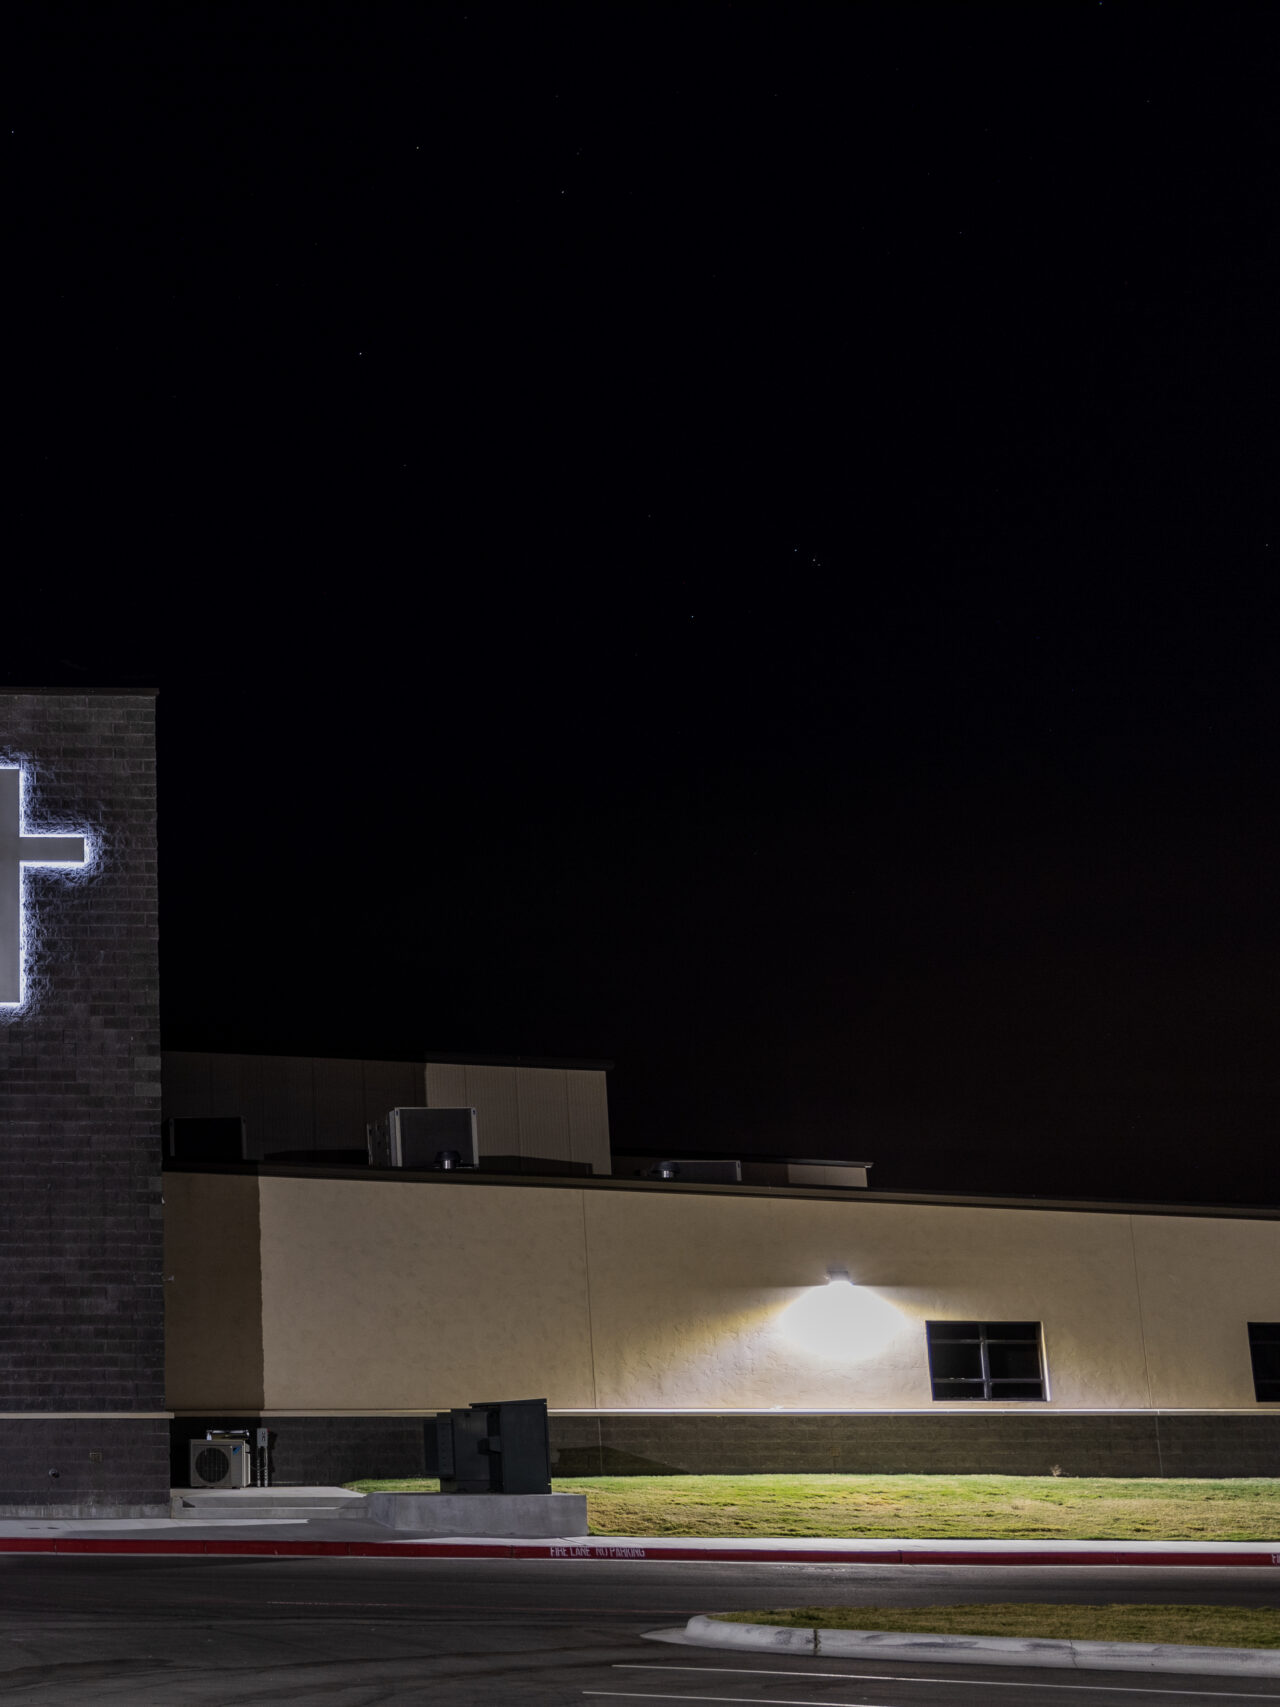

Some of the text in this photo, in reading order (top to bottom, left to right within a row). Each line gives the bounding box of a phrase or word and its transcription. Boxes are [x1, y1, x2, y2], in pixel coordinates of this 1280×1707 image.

[550, 1547, 569, 1557] FIRE
[570, 1547, 592, 1557] LANE
[610, 1547, 645, 1558] PARKING
